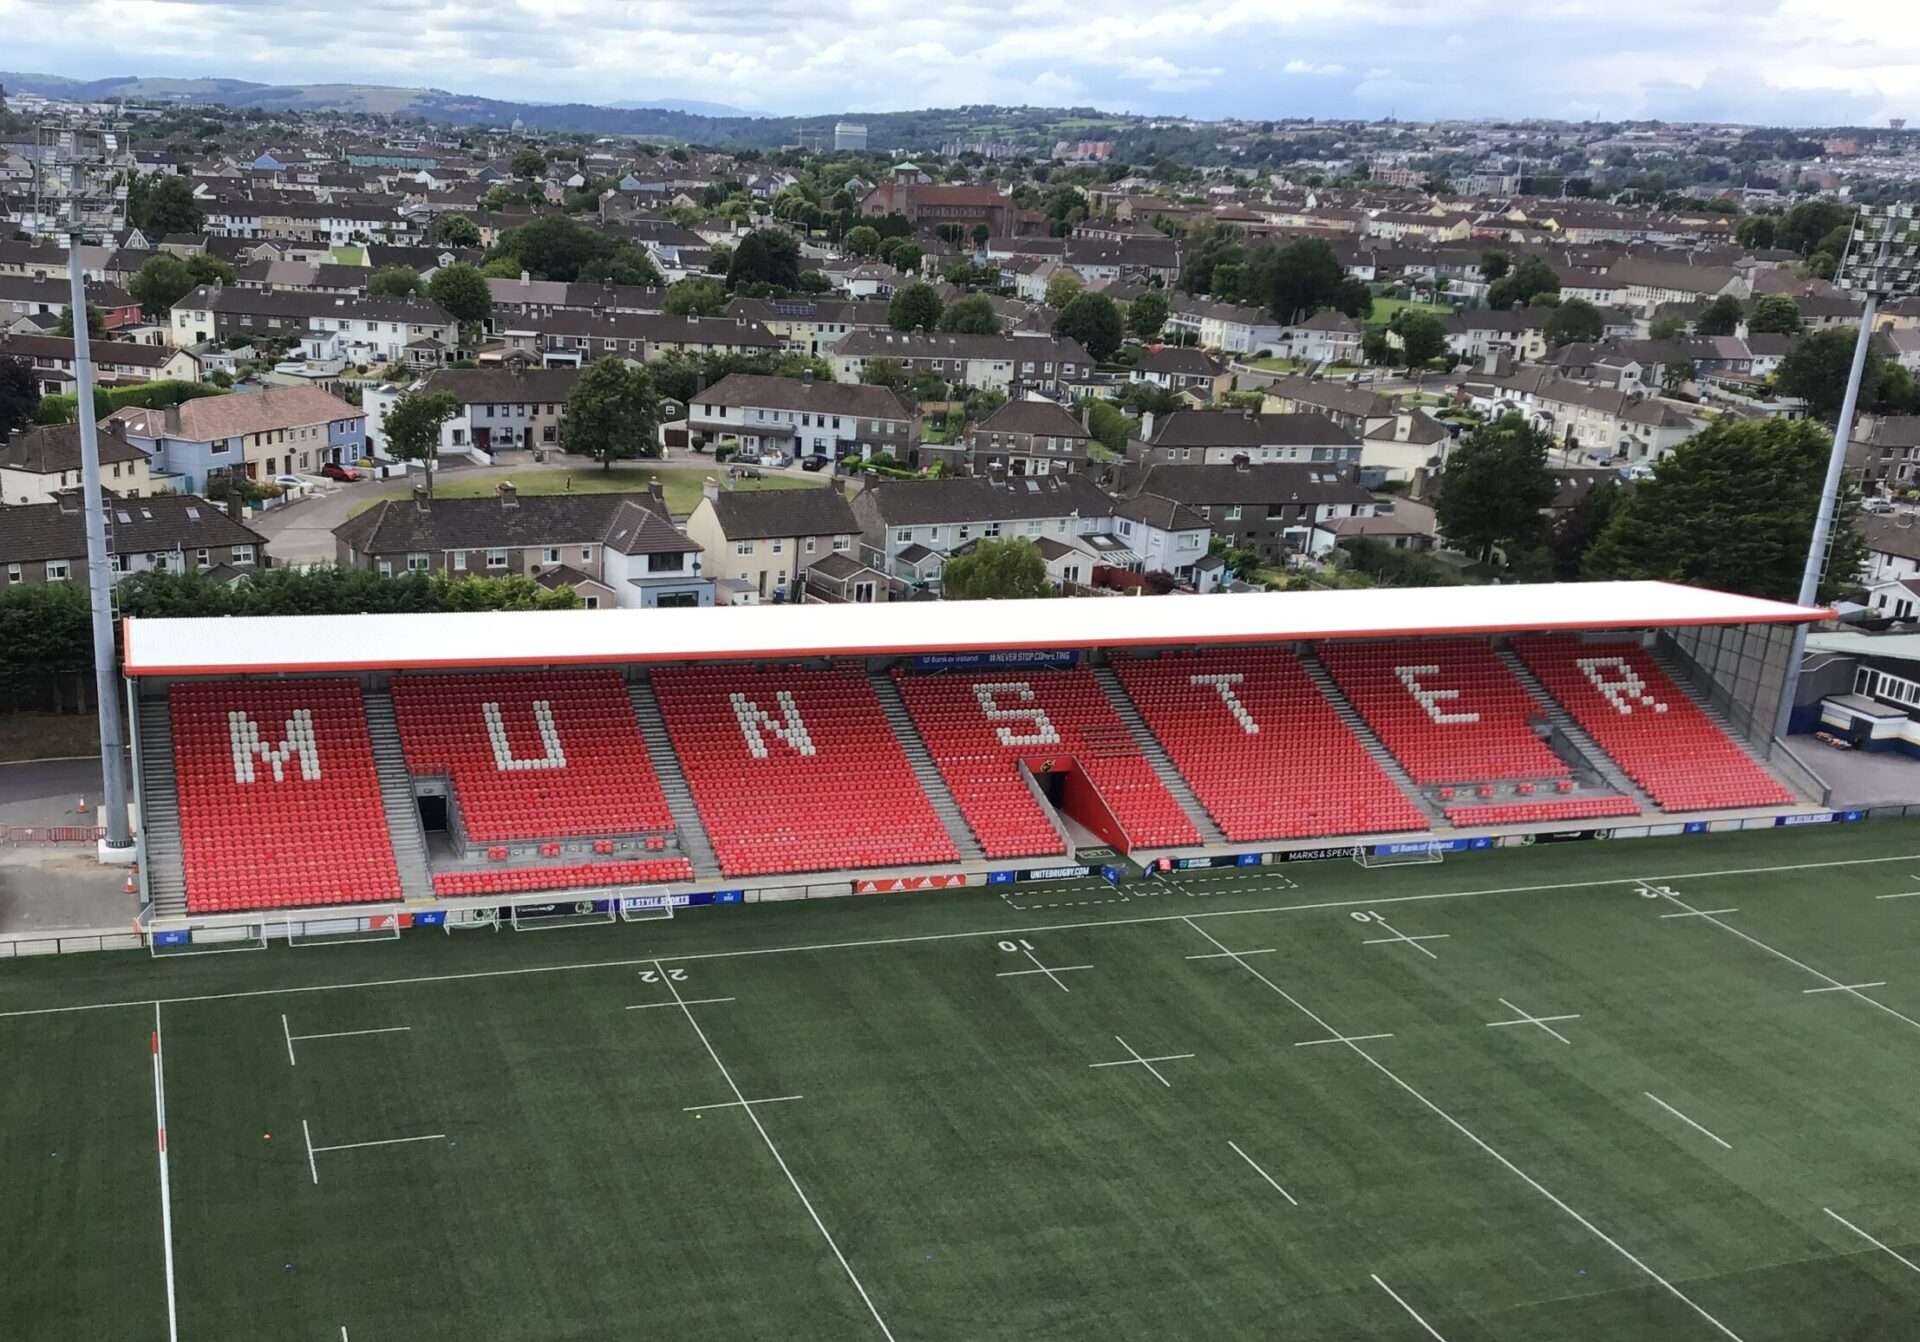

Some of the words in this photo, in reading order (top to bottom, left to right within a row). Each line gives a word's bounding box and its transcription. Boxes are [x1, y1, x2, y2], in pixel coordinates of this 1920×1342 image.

[931, 656, 948, 664] Bank
[989, 652, 1018, 662] #NEVER
[1017, 652, 1034, 661] STOP
[1288, 850, 1319, 860] MARKS
[1326, 848, 1367, 858] SPENCER
[1400, 844, 1418, 852] Bank
[1030, 866, 1090, 880] UNITEDRUGBY.COM
[1634, 886, 1680, 898] 22
[635, 897, 659, 907] STYLE
[1350, 910, 1386, 922] 10
[998, 939, 1034, 952] 10
[638, 968, 689, 983] 22
